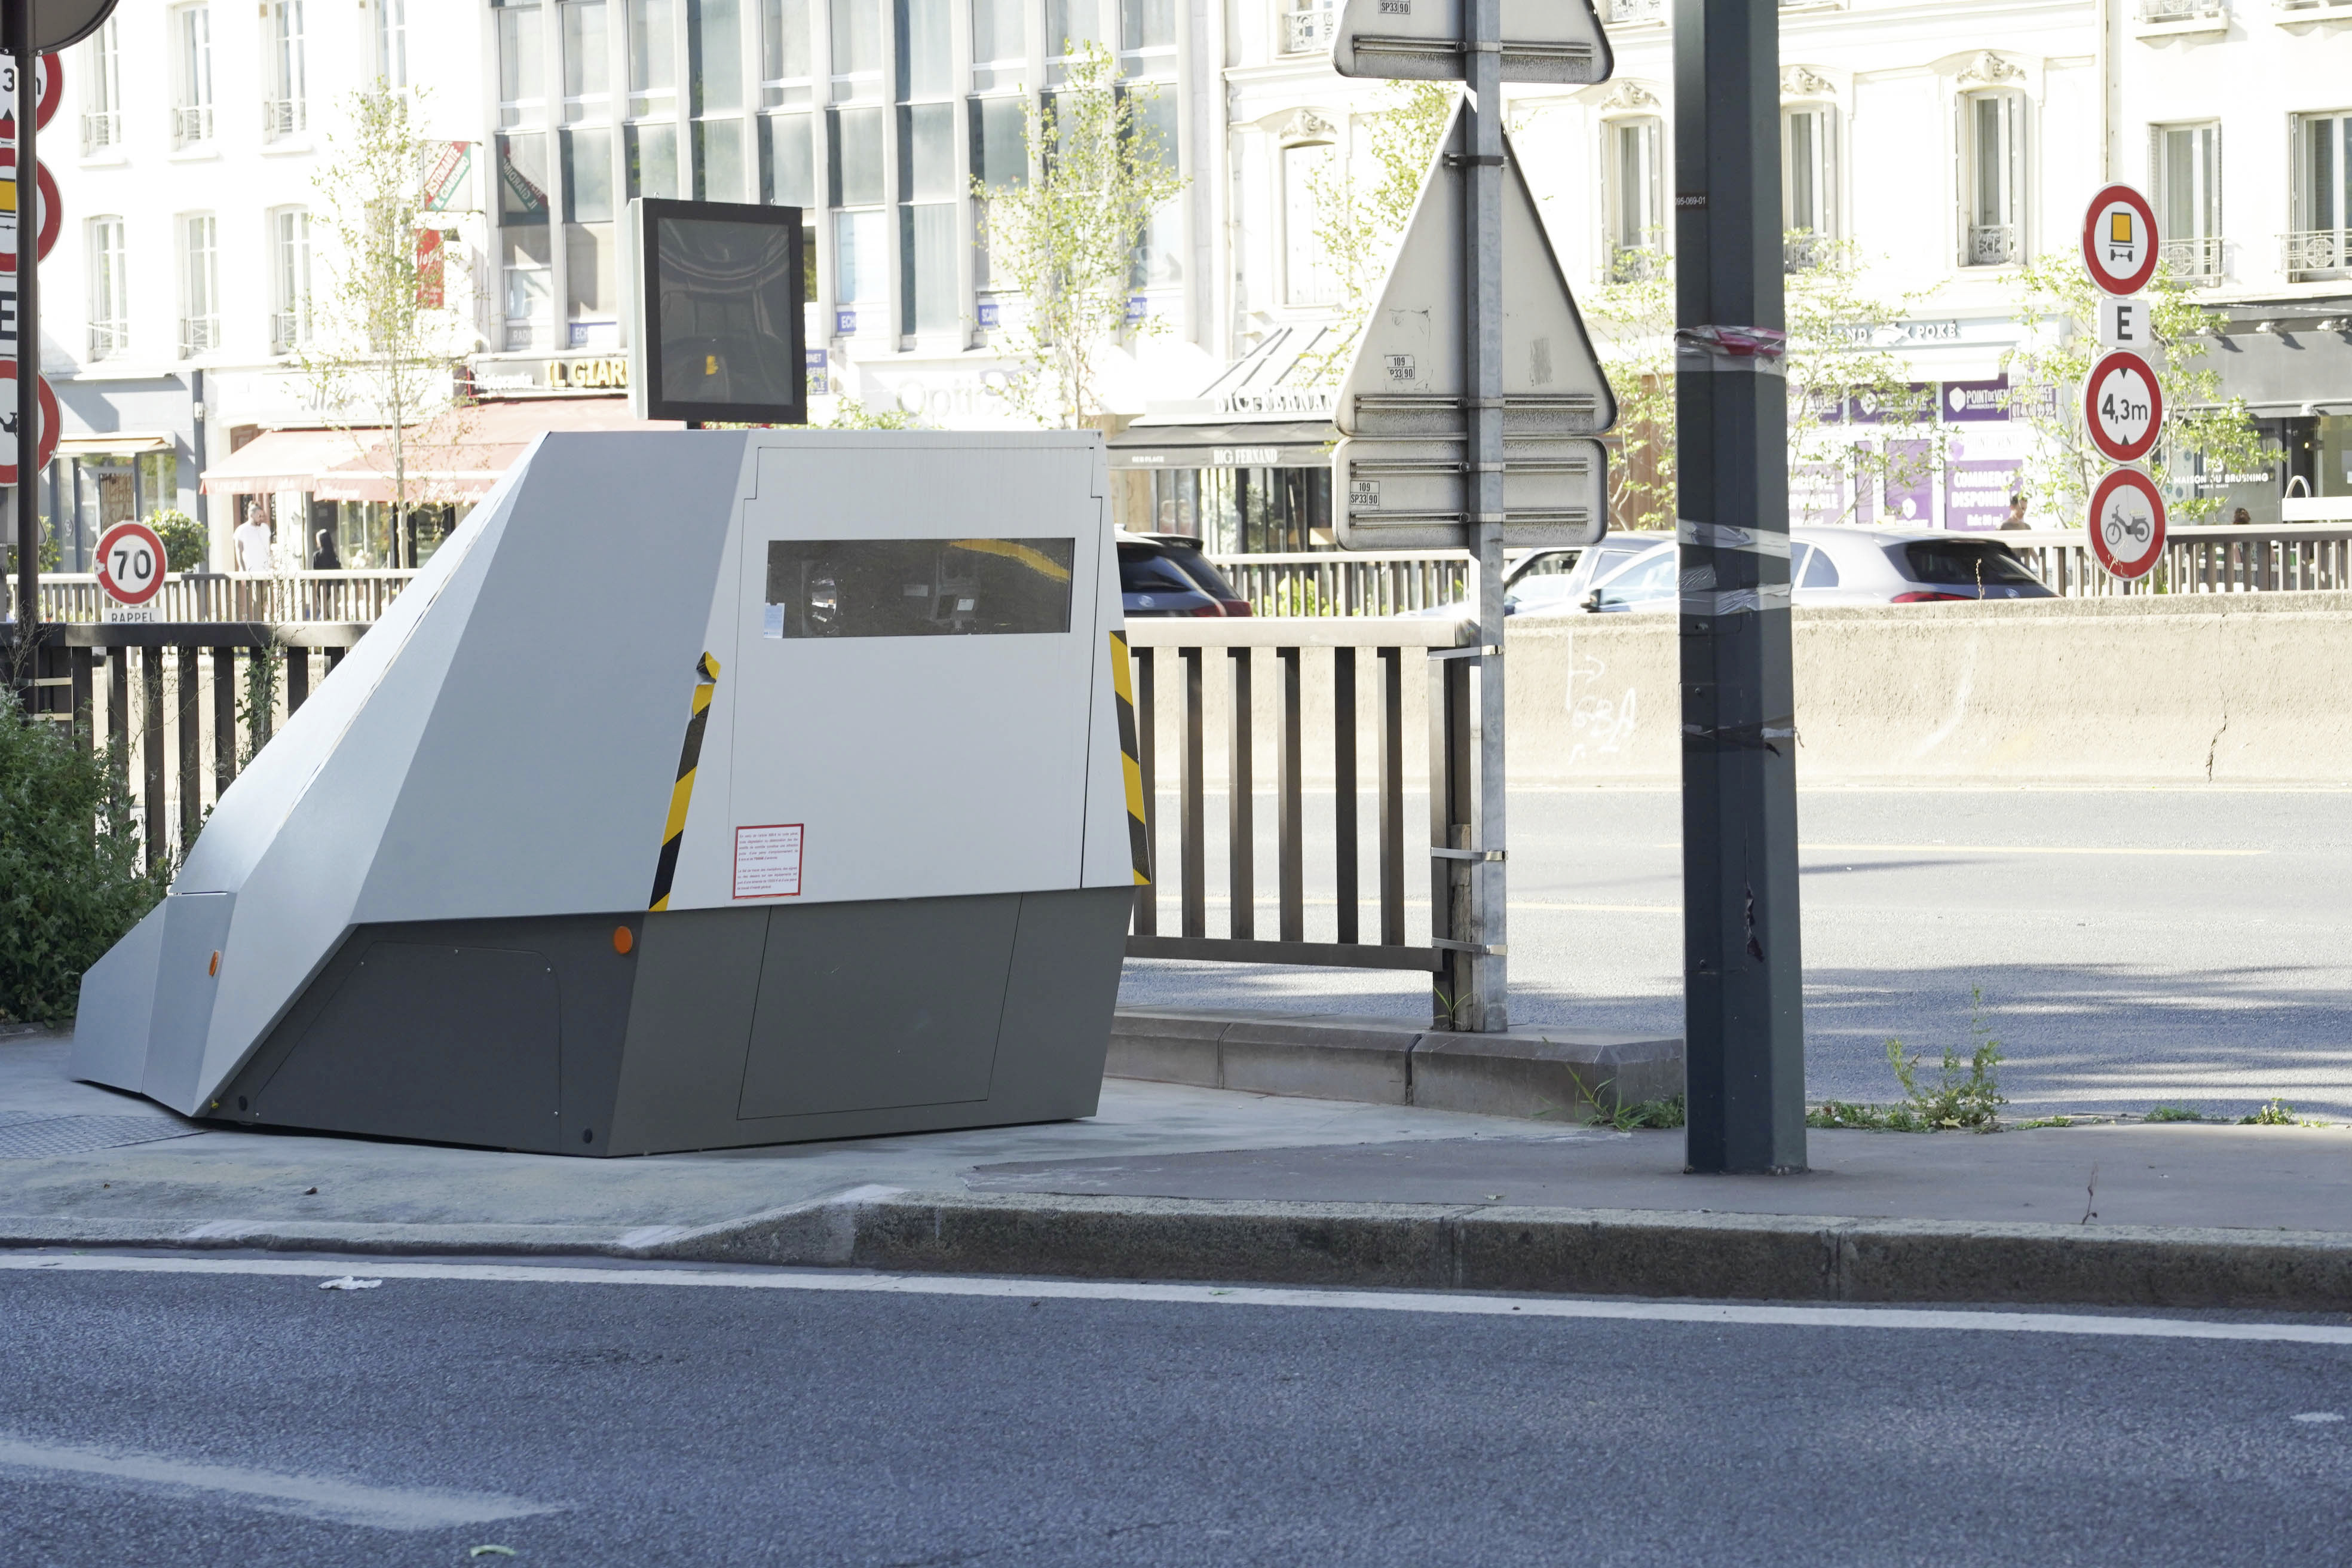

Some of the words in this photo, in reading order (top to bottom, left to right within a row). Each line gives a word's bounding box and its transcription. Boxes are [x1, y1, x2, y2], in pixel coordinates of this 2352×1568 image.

[1382, 2, 1397, 11] SP33
[1399, 4, 1408, 12] 90
[2117, 305, 2133, 341] E
[1394, 357, 1405, 366] 109
[543, 359, 566, 388] IL
[571, 357, 627, 387] GIAR
[1404, 368, 1413, 378] 90
[2102, 394, 2148, 425] 4,3m
[1214, 449, 1233, 465] BIG
[1235, 449, 1278, 464] FERNAND
[2173, 474, 2207, 485] MAISON
[1359, 482, 1370, 492] 109
[1350, 494, 1367, 503] SP33
[1368, 494, 1377, 504] 90
[114, 550, 152, 580] 70
[111, 612, 155, 622] RAPPEL
